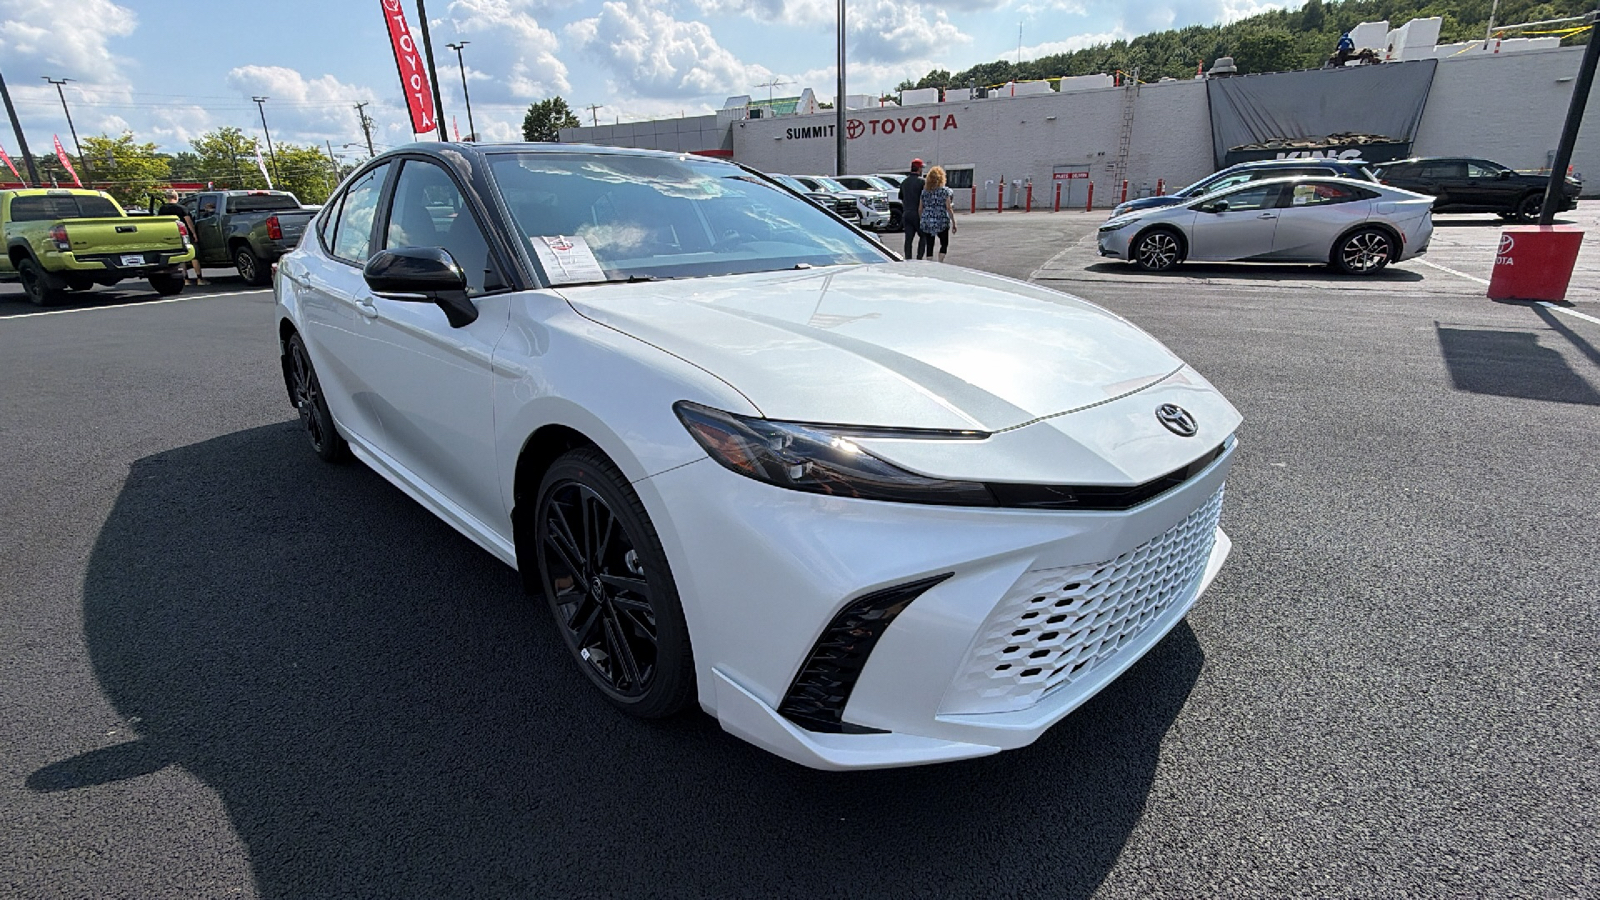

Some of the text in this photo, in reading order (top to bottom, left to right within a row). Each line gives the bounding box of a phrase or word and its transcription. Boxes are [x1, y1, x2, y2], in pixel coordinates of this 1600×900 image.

[393, 15, 431, 127] TOYOTA
[786, 114, 958, 140] SUMMIT TOYOTA
